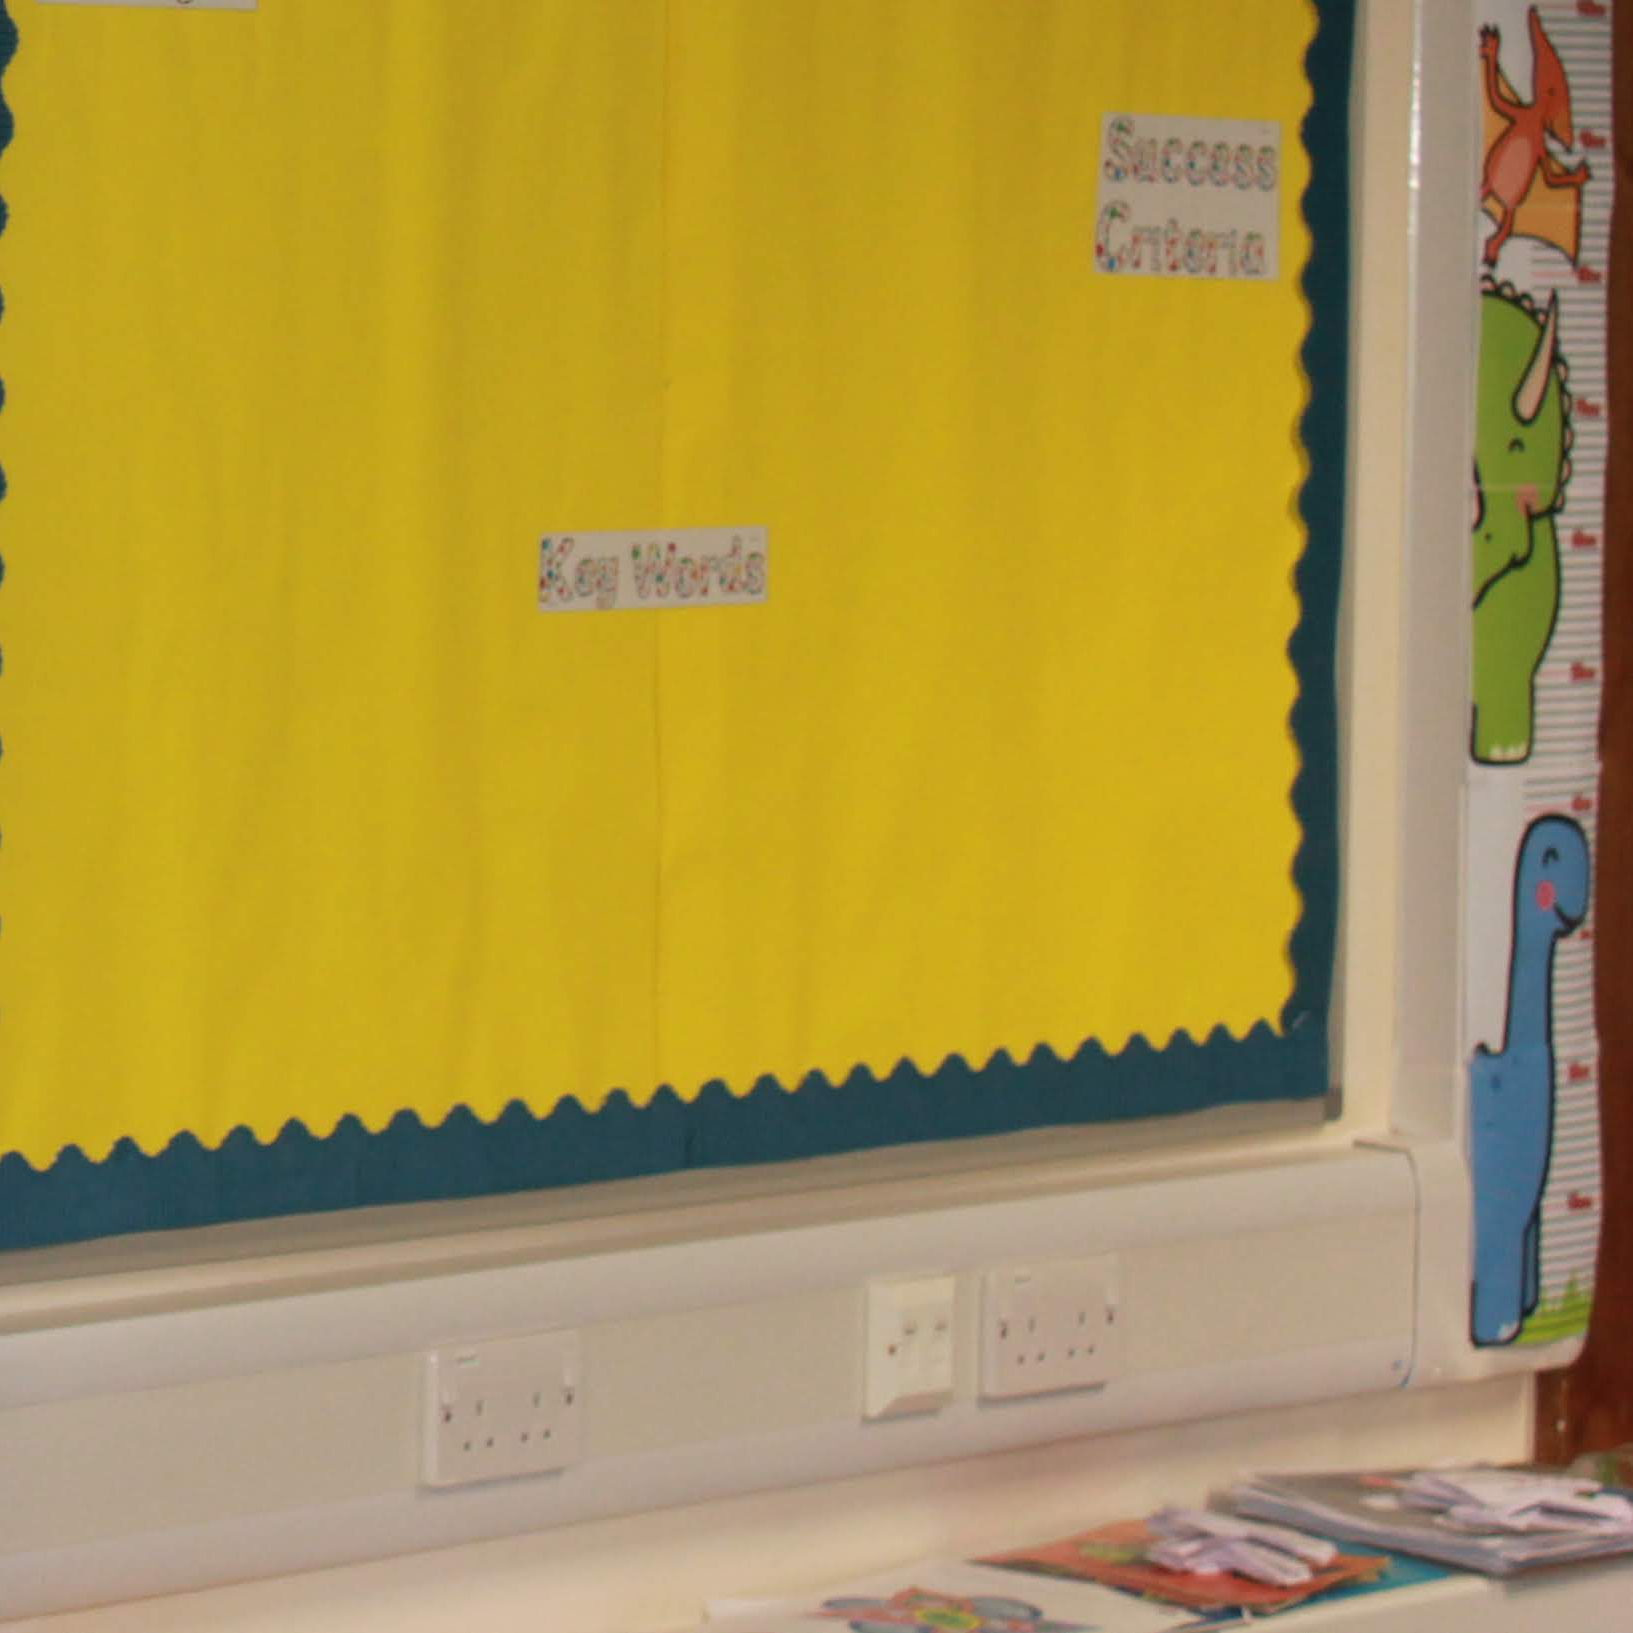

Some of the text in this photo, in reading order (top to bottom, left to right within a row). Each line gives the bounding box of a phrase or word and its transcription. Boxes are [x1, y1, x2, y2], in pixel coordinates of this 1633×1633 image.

[1104, 116, 1276, 192] Success
[1095, 200, 1266, 275] Criteria
[538, 535, 765, 610] Key Words
